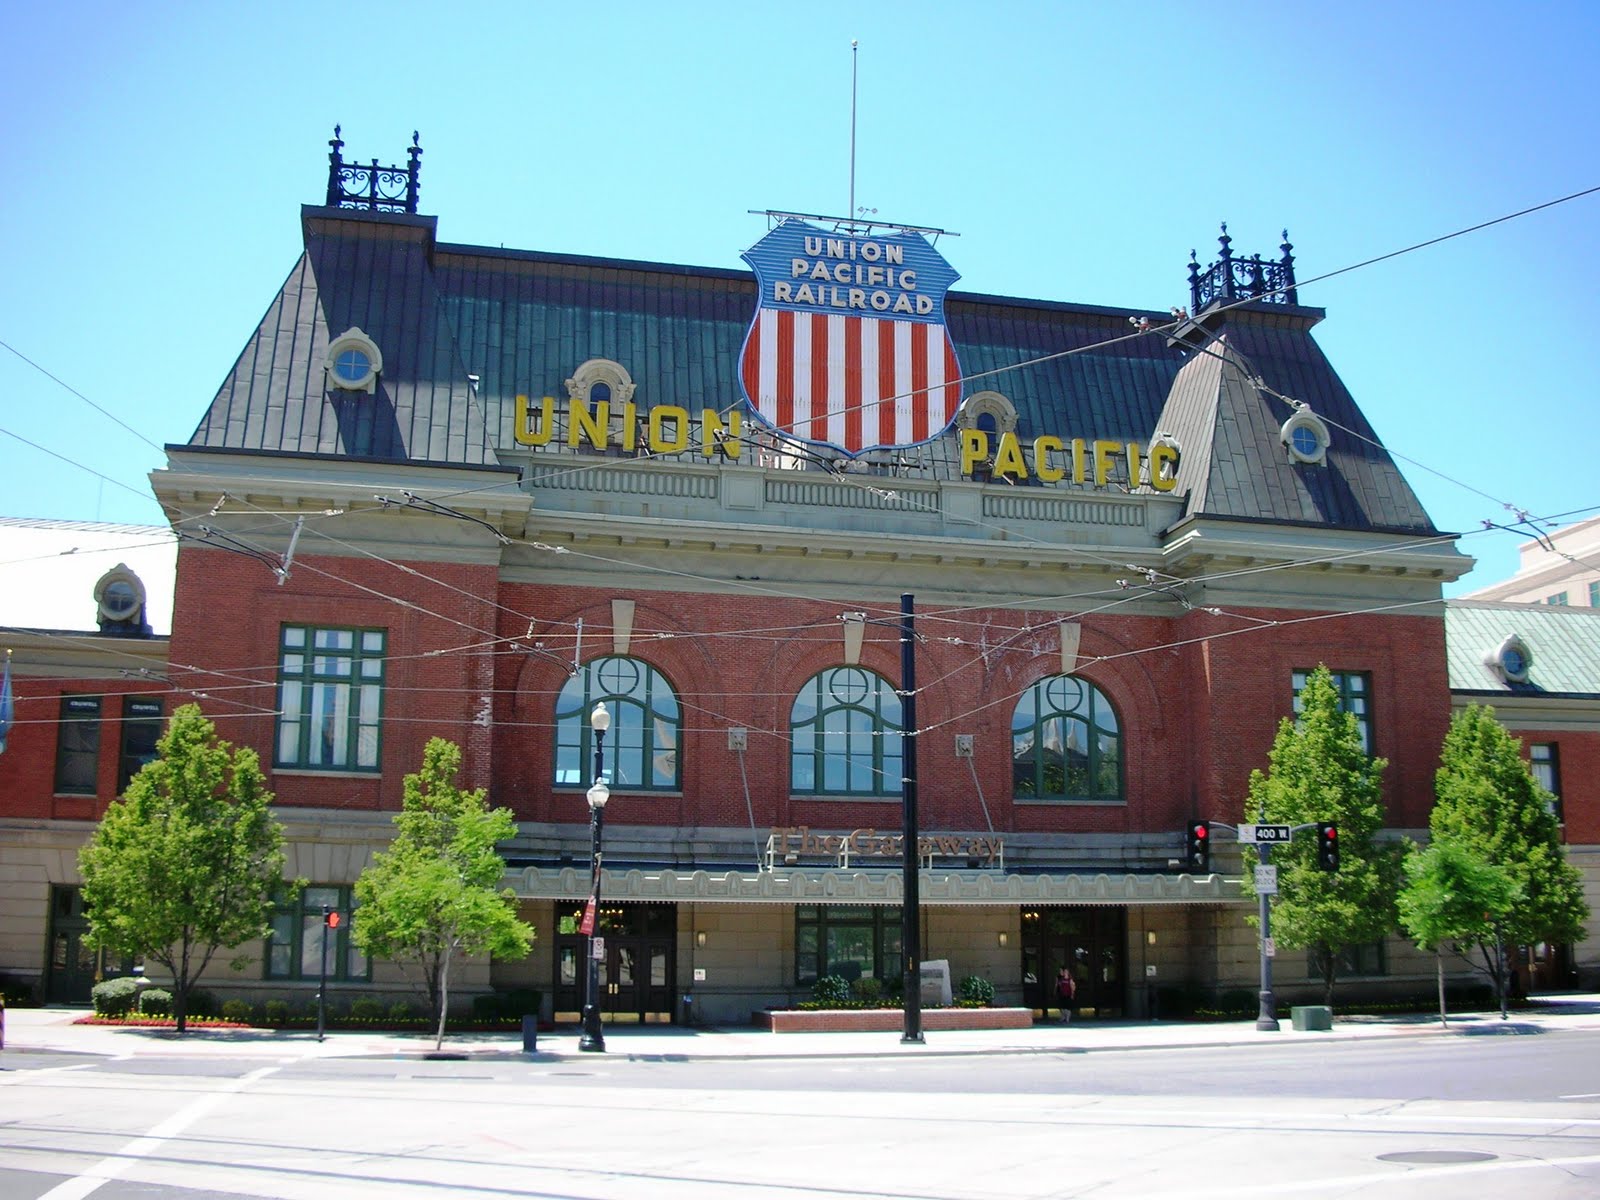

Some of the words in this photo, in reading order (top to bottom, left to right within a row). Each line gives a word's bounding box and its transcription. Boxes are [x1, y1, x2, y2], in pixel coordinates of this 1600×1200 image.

[804, 236, 903, 265] UNION
[792, 258, 916, 291] PACIFIC
[774, 281, 934, 315] RAILROAD
[514, 394, 742, 460] UNION
[960, 428, 1178, 492] PACIFIC
[771, 825, 841, 855] The
[849, 828, 1004, 864] Gaeway
[1257, 829, 1276, 838] 400
